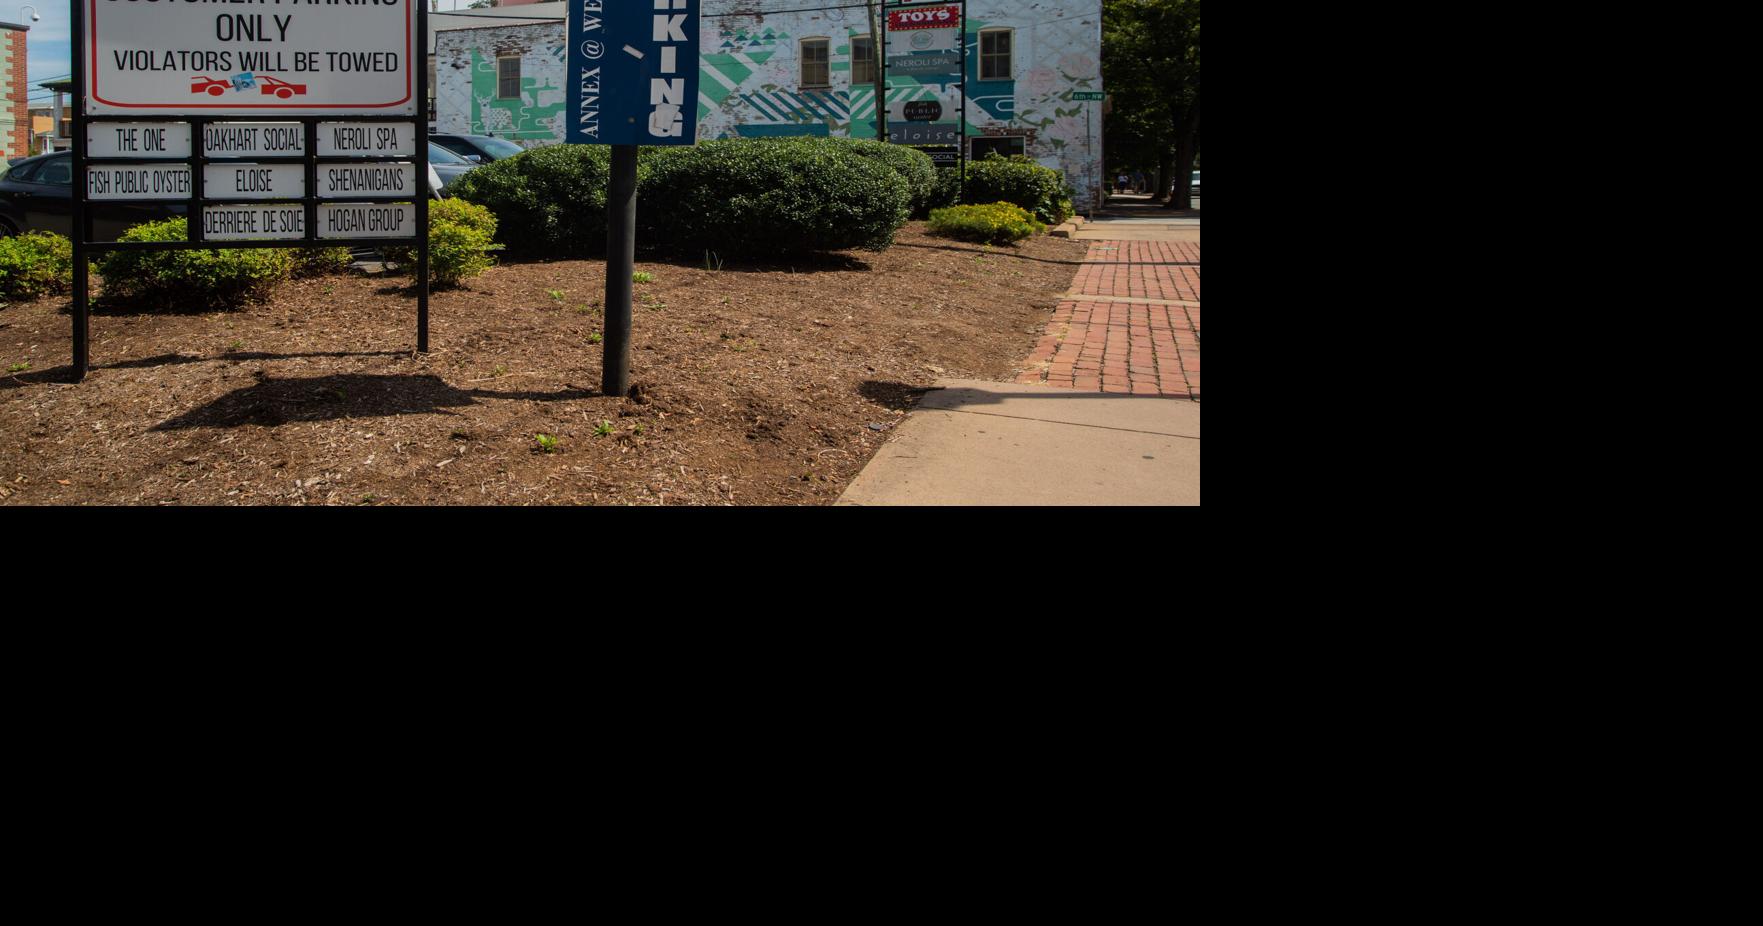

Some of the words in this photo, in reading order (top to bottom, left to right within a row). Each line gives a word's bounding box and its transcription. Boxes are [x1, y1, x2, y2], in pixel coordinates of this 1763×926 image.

[898, 9, 950, 22] TOYS
[216, 14, 291, 41] ONLY
[114, 50, 232, 72] VIOLATORS
[239, 51, 288, 72] WILL
[295, 52, 320, 72] BE
[326, 52, 398, 72] TOWED
[581, 40, 604, 59] @
[895, 59, 930, 67] NEROLI
[932, 57, 950, 66] SPA
[580, 67, 601, 138] ANNEX
[116, 129, 138, 151] THE
[144, 129, 166, 151] ONE
[206, 128, 258, 151] OAKHART
[264, 128, 302, 151] SOCIAL
[334, 128, 371, 150] NEROLI
[377, 128, 397, 150] SPA
[890, 128, 955, 140] eloise
[89, 171, 110, 194] FISH
[116, 171, 149, 194] PUBLIC
[154, 170, 191, 193] OYSTER
[236, 169, 272, 192] ELOISE
[329, 168, 404, 191] SHENANIGANS
[206, 210, 257, 234] DERRIERE
[263, 210, 277, 233] DE
[280, 209, 303, 233] SOIE
[329, 208, 366, 231] HOGAN
[369, 208, 404, 231] GROUP
